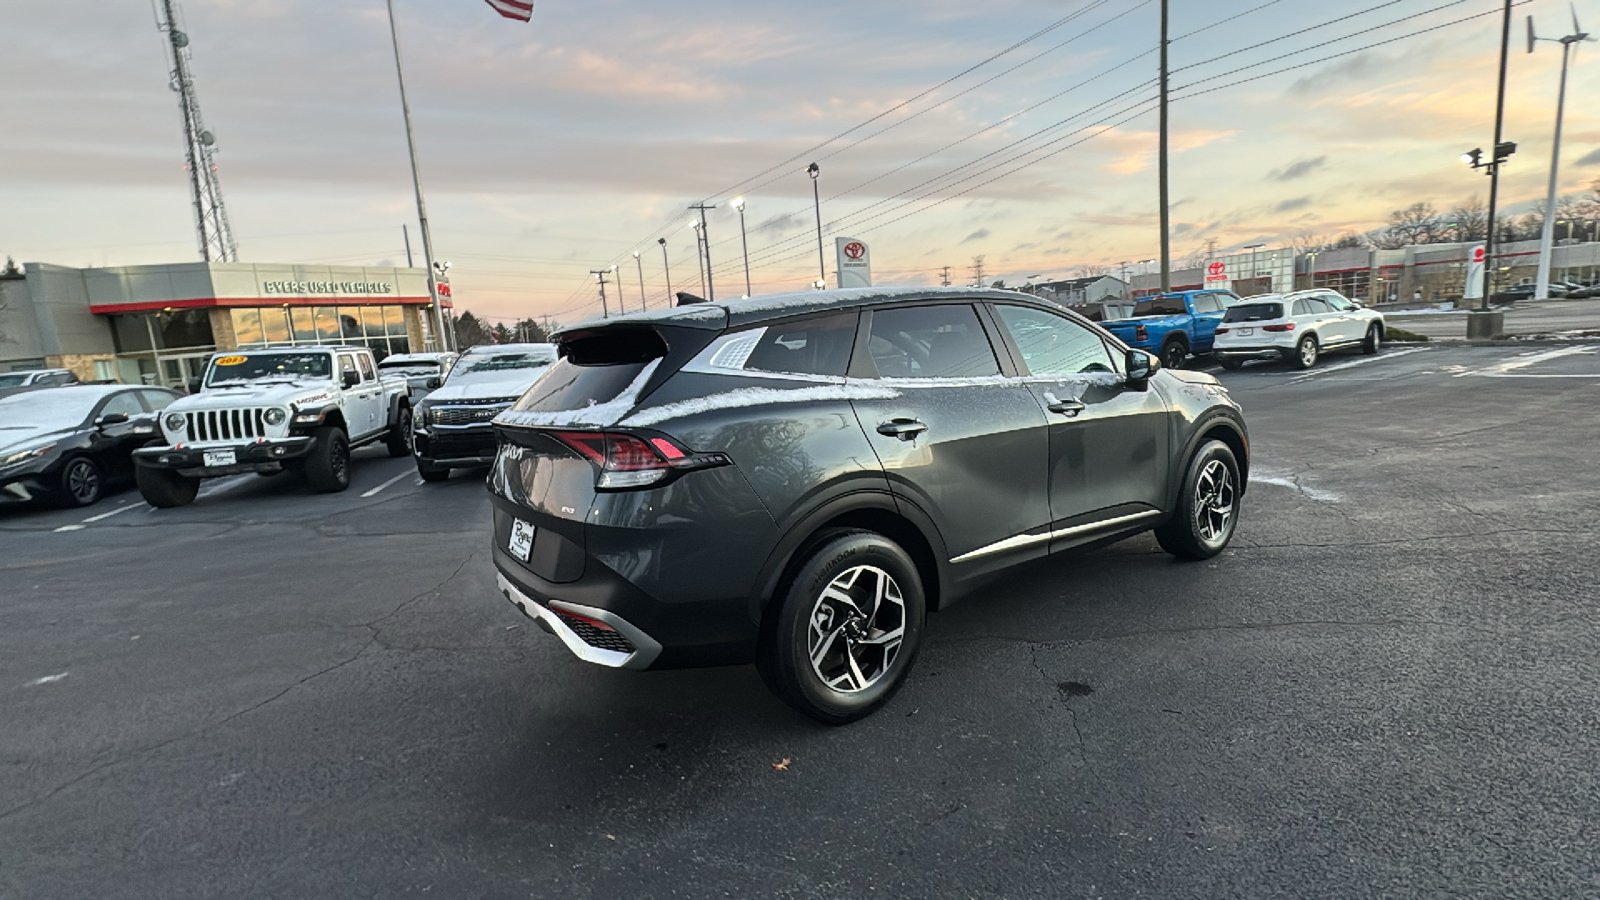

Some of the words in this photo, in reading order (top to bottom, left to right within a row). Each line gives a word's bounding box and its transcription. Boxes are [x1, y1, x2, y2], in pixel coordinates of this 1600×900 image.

[264, 281, 308, 294] BYERS
[308, 281, 339, 294] USED
[341, 281, 392, 294] VEHICLES
